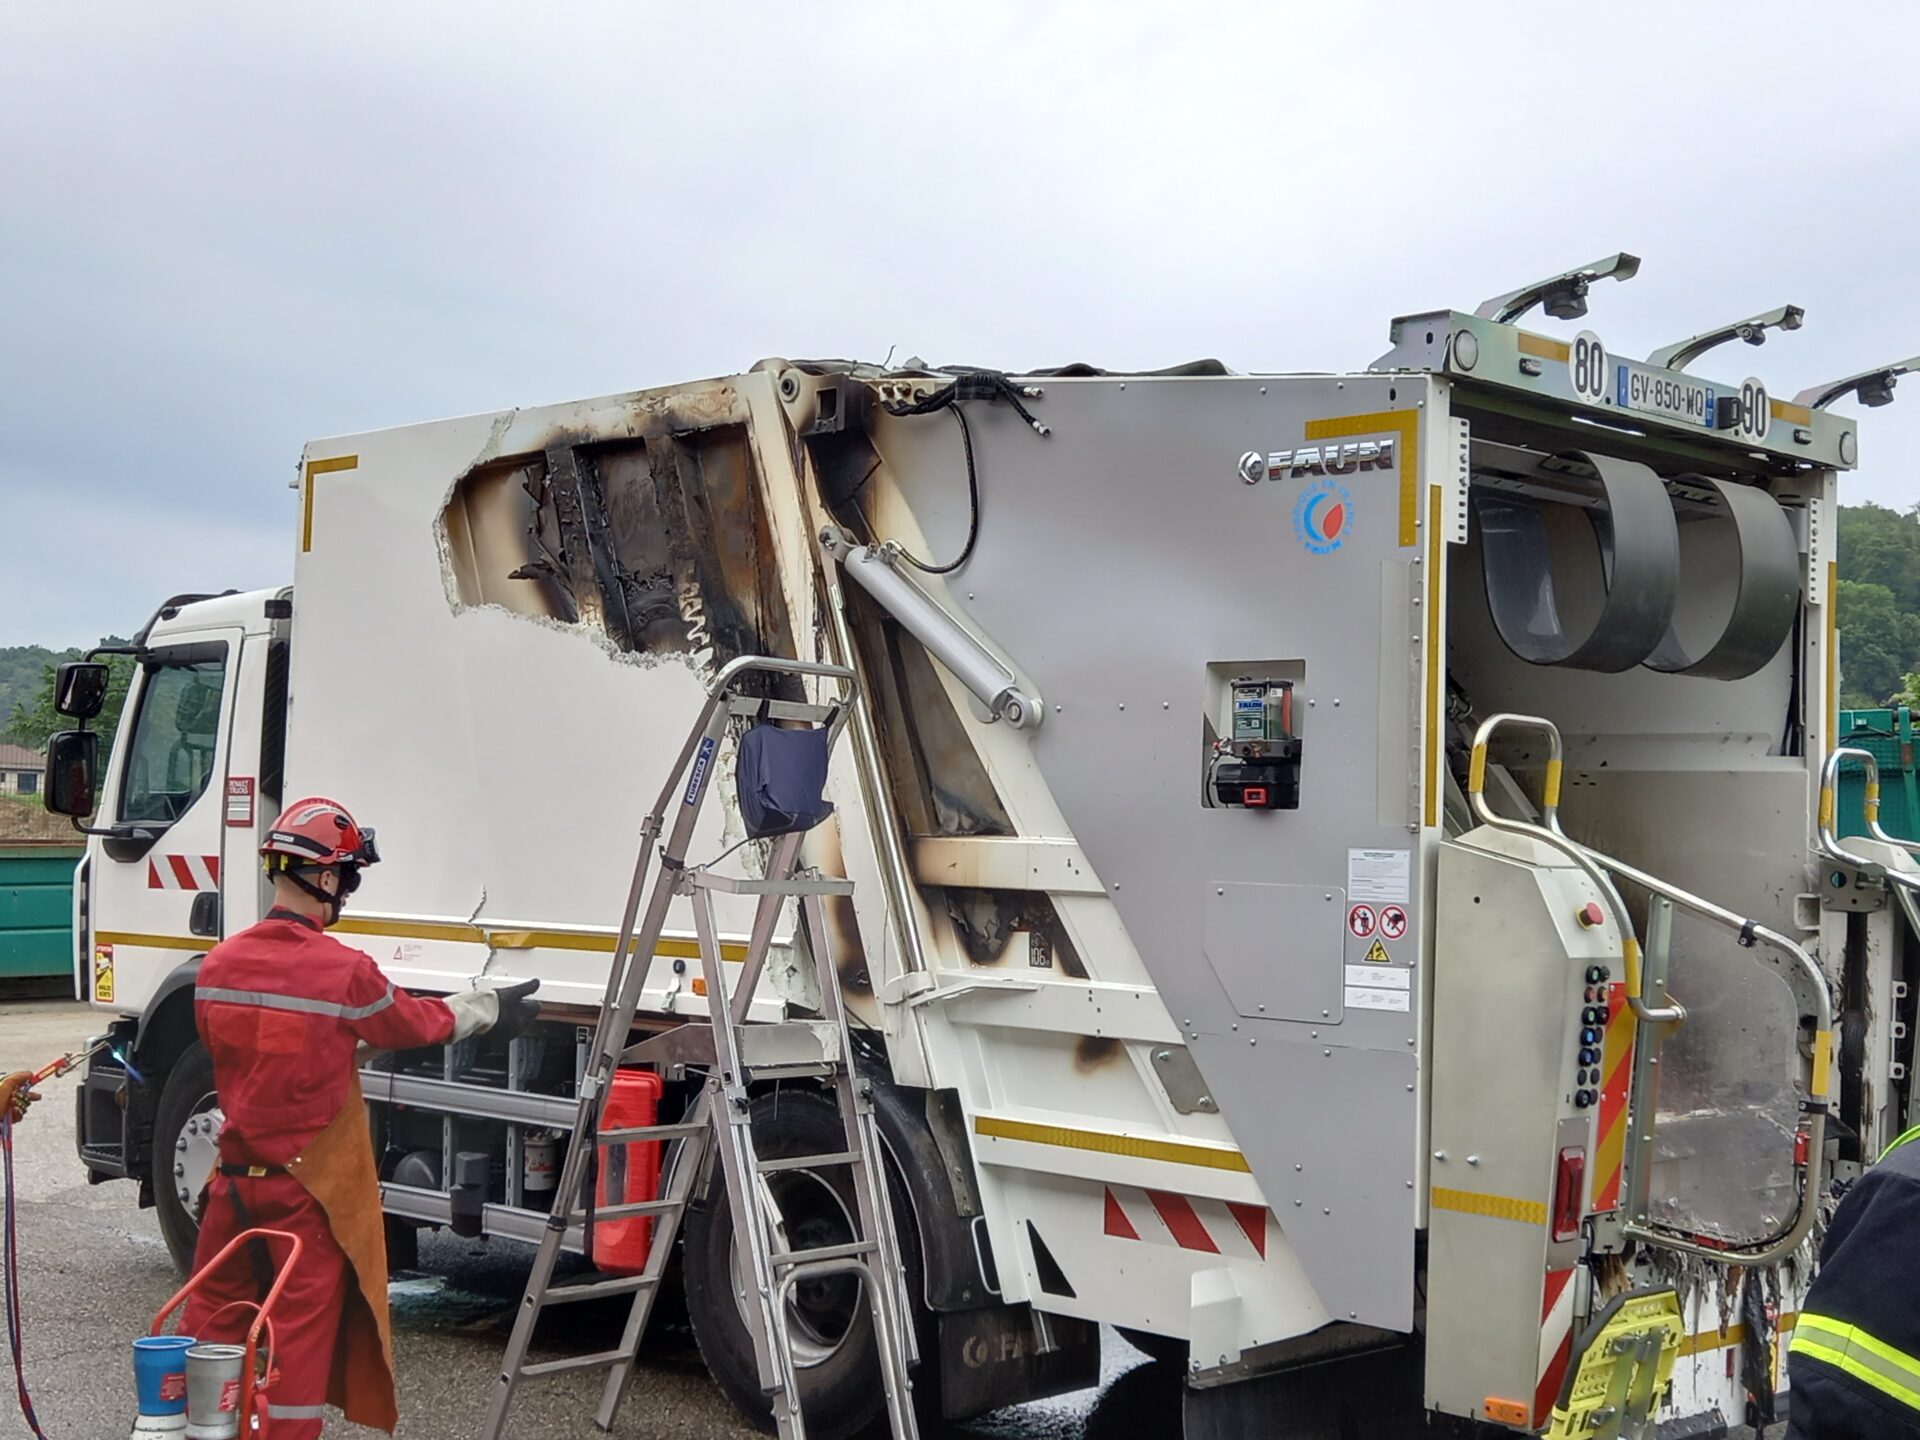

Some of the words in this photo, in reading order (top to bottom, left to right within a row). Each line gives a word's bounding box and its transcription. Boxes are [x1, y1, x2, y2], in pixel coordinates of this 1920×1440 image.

[1575, 337, 1601, 397] 80
[1631, 373, 1703, 416] GV-850-WQ
[1743, 383, 1766, 438] 90
[1268, 439, 1394, 481] FAUN
[1031, 947, 1046, 966] 106
